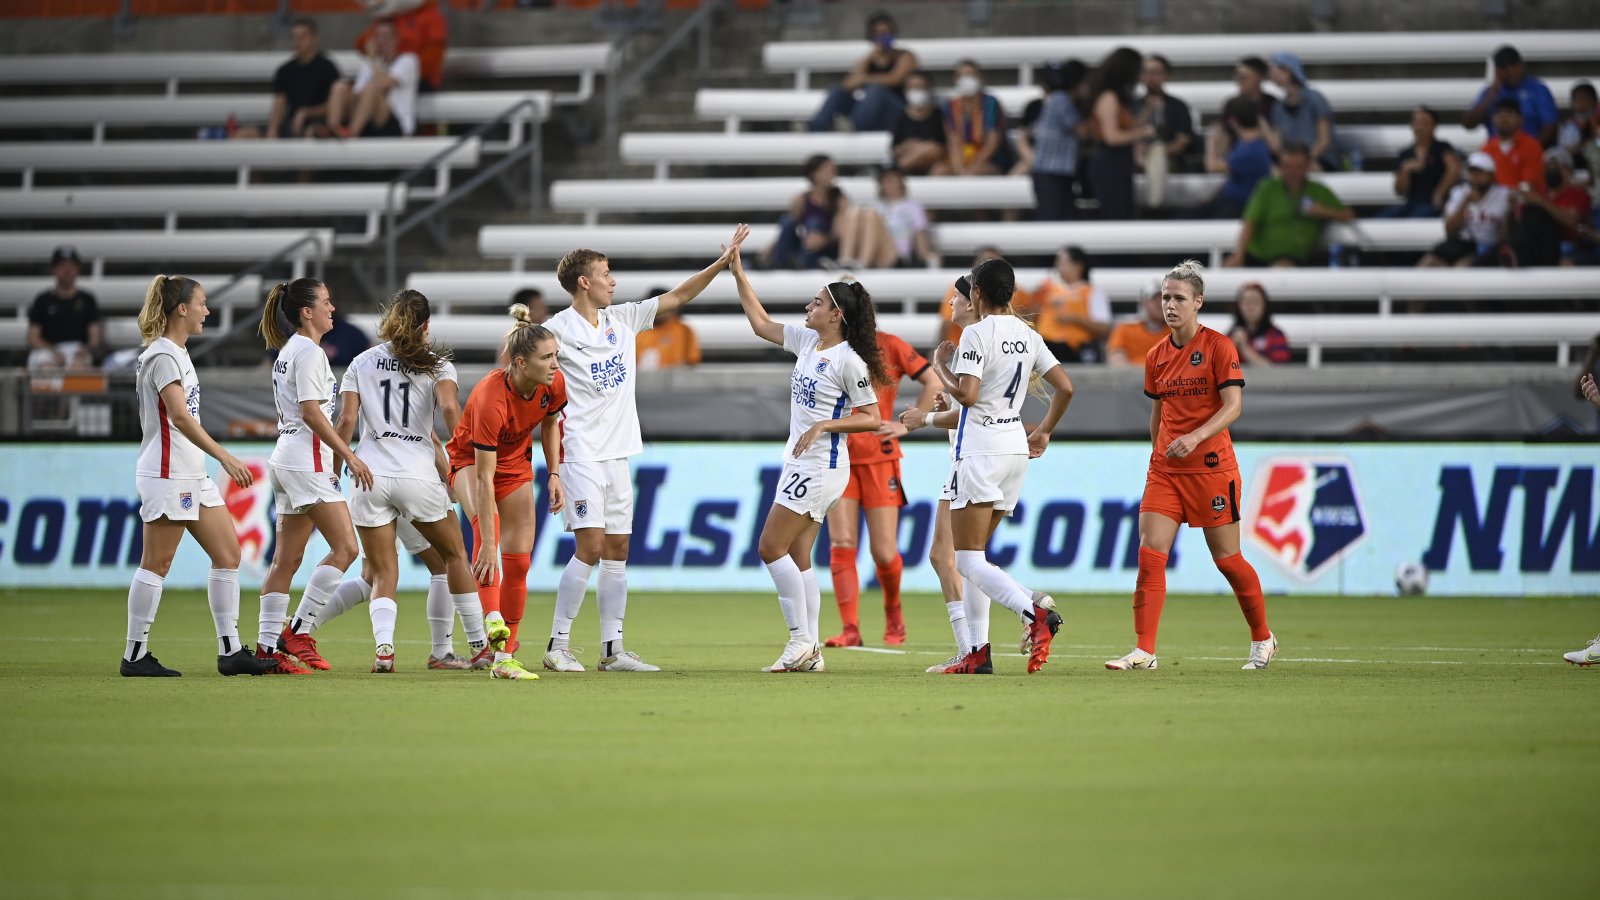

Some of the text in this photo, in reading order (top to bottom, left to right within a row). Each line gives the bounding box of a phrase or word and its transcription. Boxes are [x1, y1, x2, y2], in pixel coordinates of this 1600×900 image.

[962, 350, 983, 365] ally
[791, 382, 816, 401] TURE
[856, 377, 869, 389] al
[1002, 361, 1023, 409] 4
[1164, 376, 1208, 388] Anderson
[1177, 386, 1210, 397] Center
[380, 378, 411, 429] 11
[381, 431, 424, 442] BOEING
[782, 472, 812, 499] 26
[950, 470, 958, 496] 4
[0, 496, 145, 567] om
